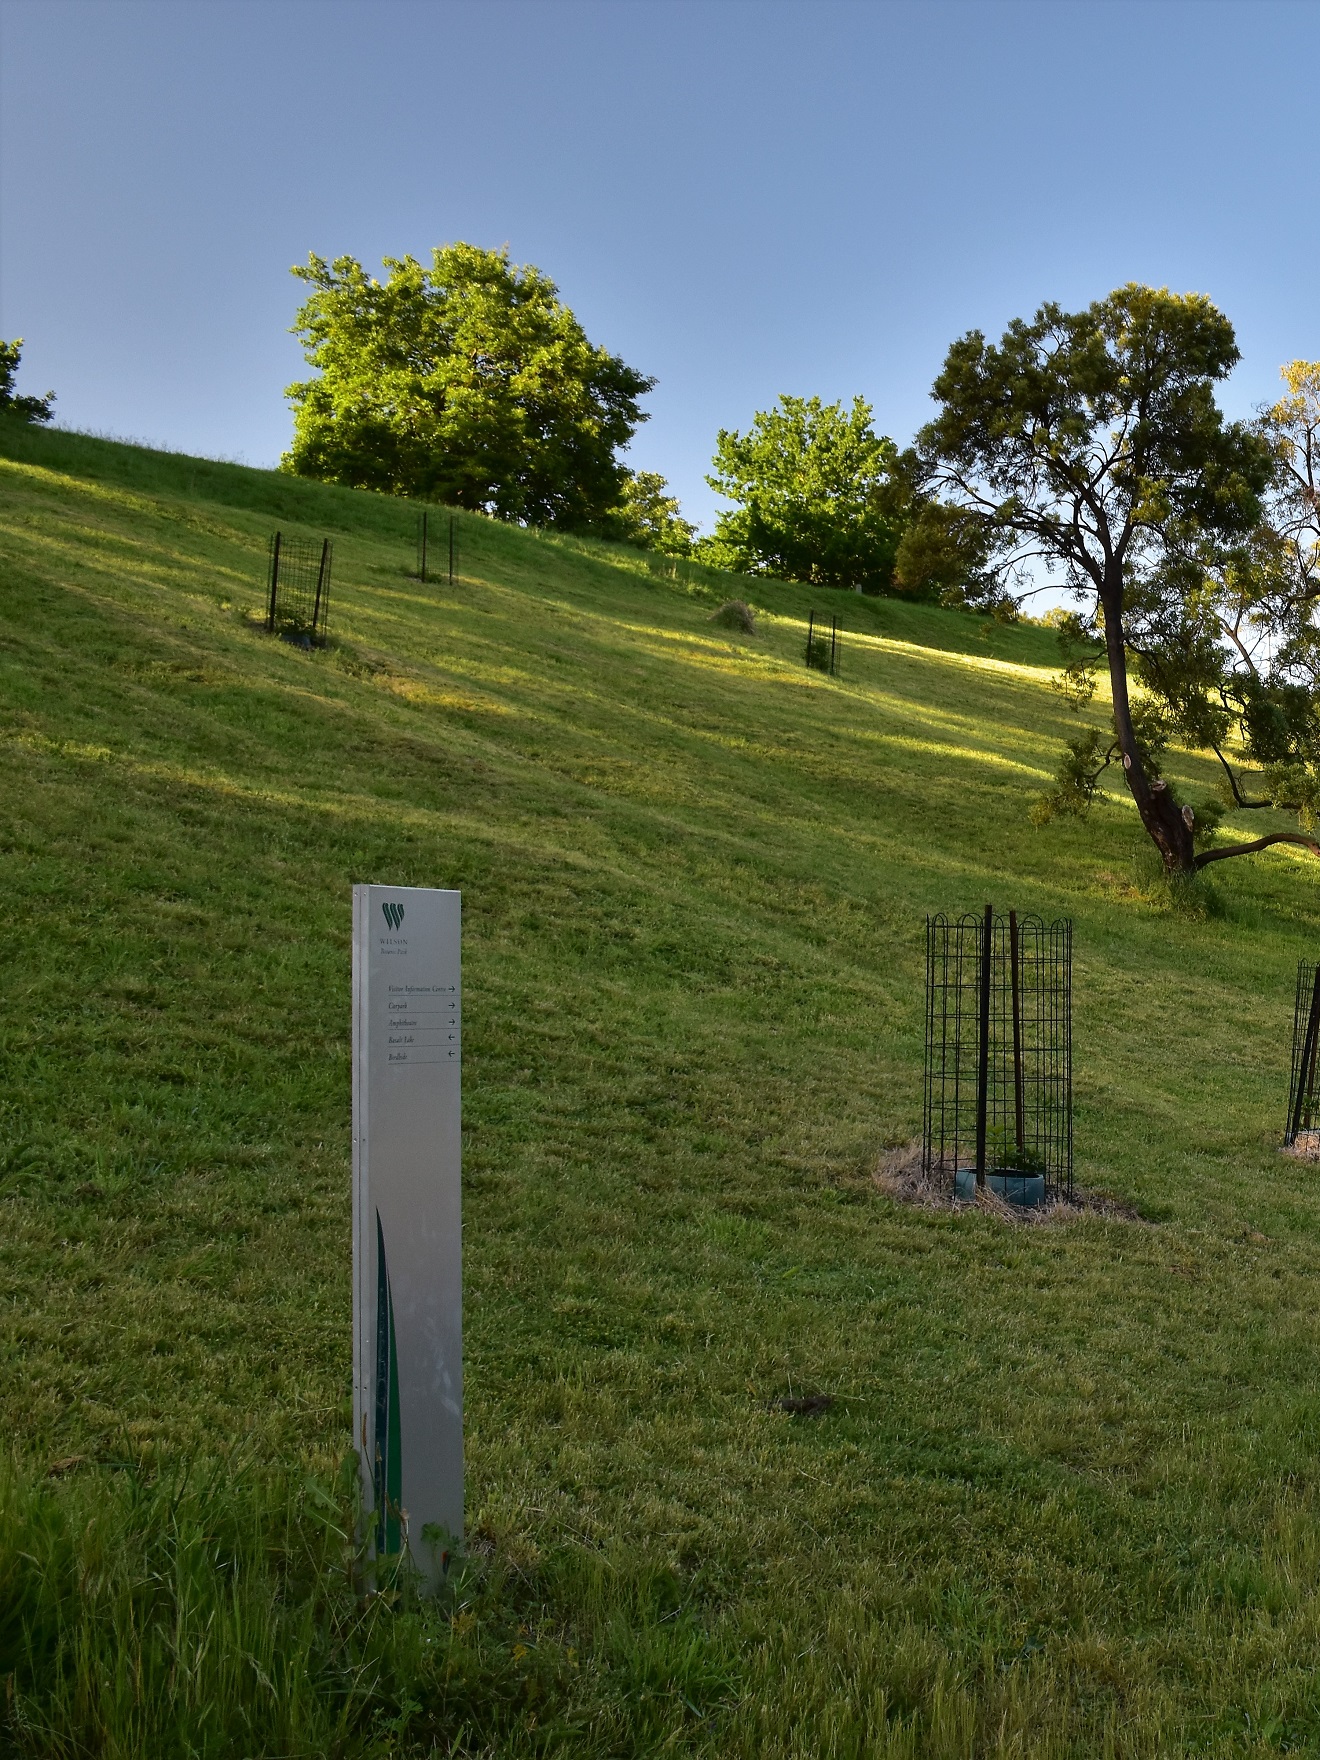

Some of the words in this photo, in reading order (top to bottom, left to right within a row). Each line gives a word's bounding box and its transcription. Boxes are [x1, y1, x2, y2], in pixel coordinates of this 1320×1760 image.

[379, 938, 408, 946] WILSON
[388, 985, 404, 993] Visitor
[405, 985, 430, 995] Information
[388, 1002, 408, 1012] Carpark
[388, 1019, 418, 1029] Amphitheatre
[404, 1035, 415, 1044] Lake
